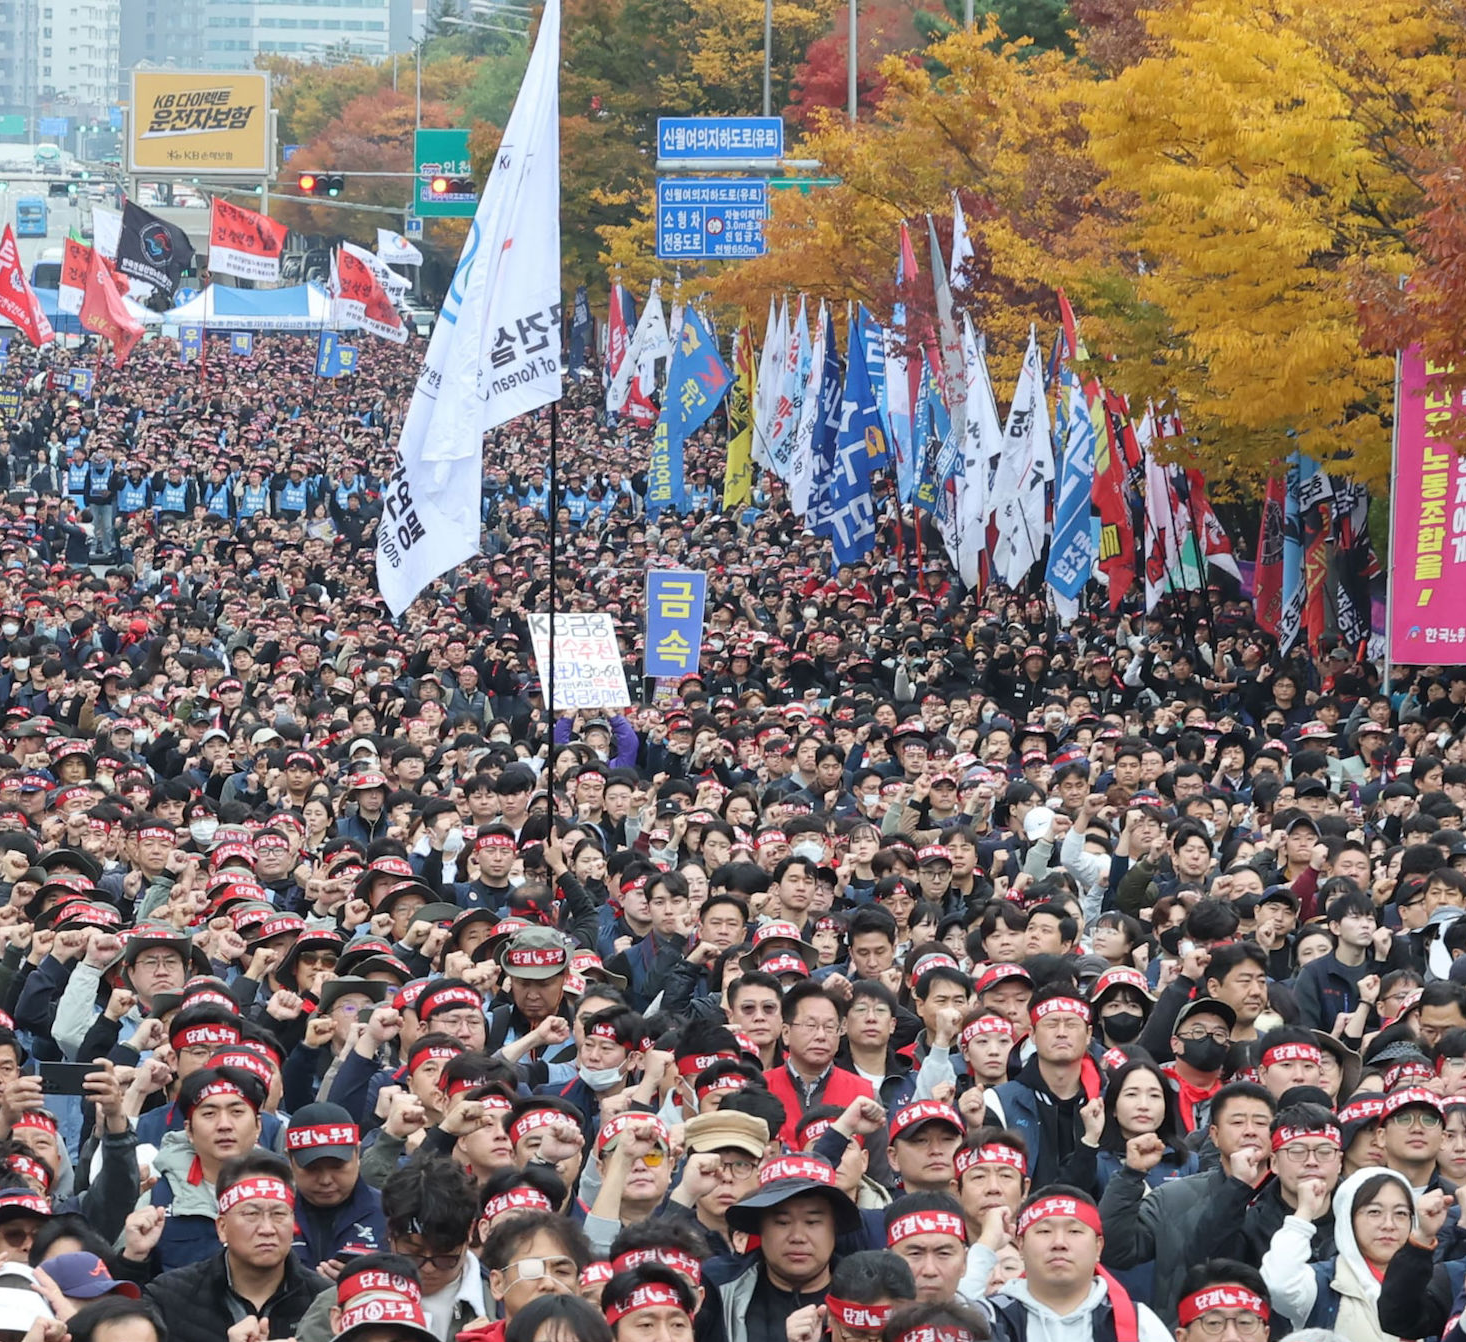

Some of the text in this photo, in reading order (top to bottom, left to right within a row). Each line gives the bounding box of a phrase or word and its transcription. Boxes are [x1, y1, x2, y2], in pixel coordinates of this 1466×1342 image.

[153, 91, 231, 109] KB 다이렉트
[148, 105, 257, 132] 운전자보험
[663, 127, 779, 152] 신월여의지하도로(유료)
[664, 188, 762, 203] 신월여의지하도로(유료)
[663, 232, 702, 252] 전용도로
[655, 580, 697, 669] 금속
[1424, 627, 1466, 643] 한국노총
